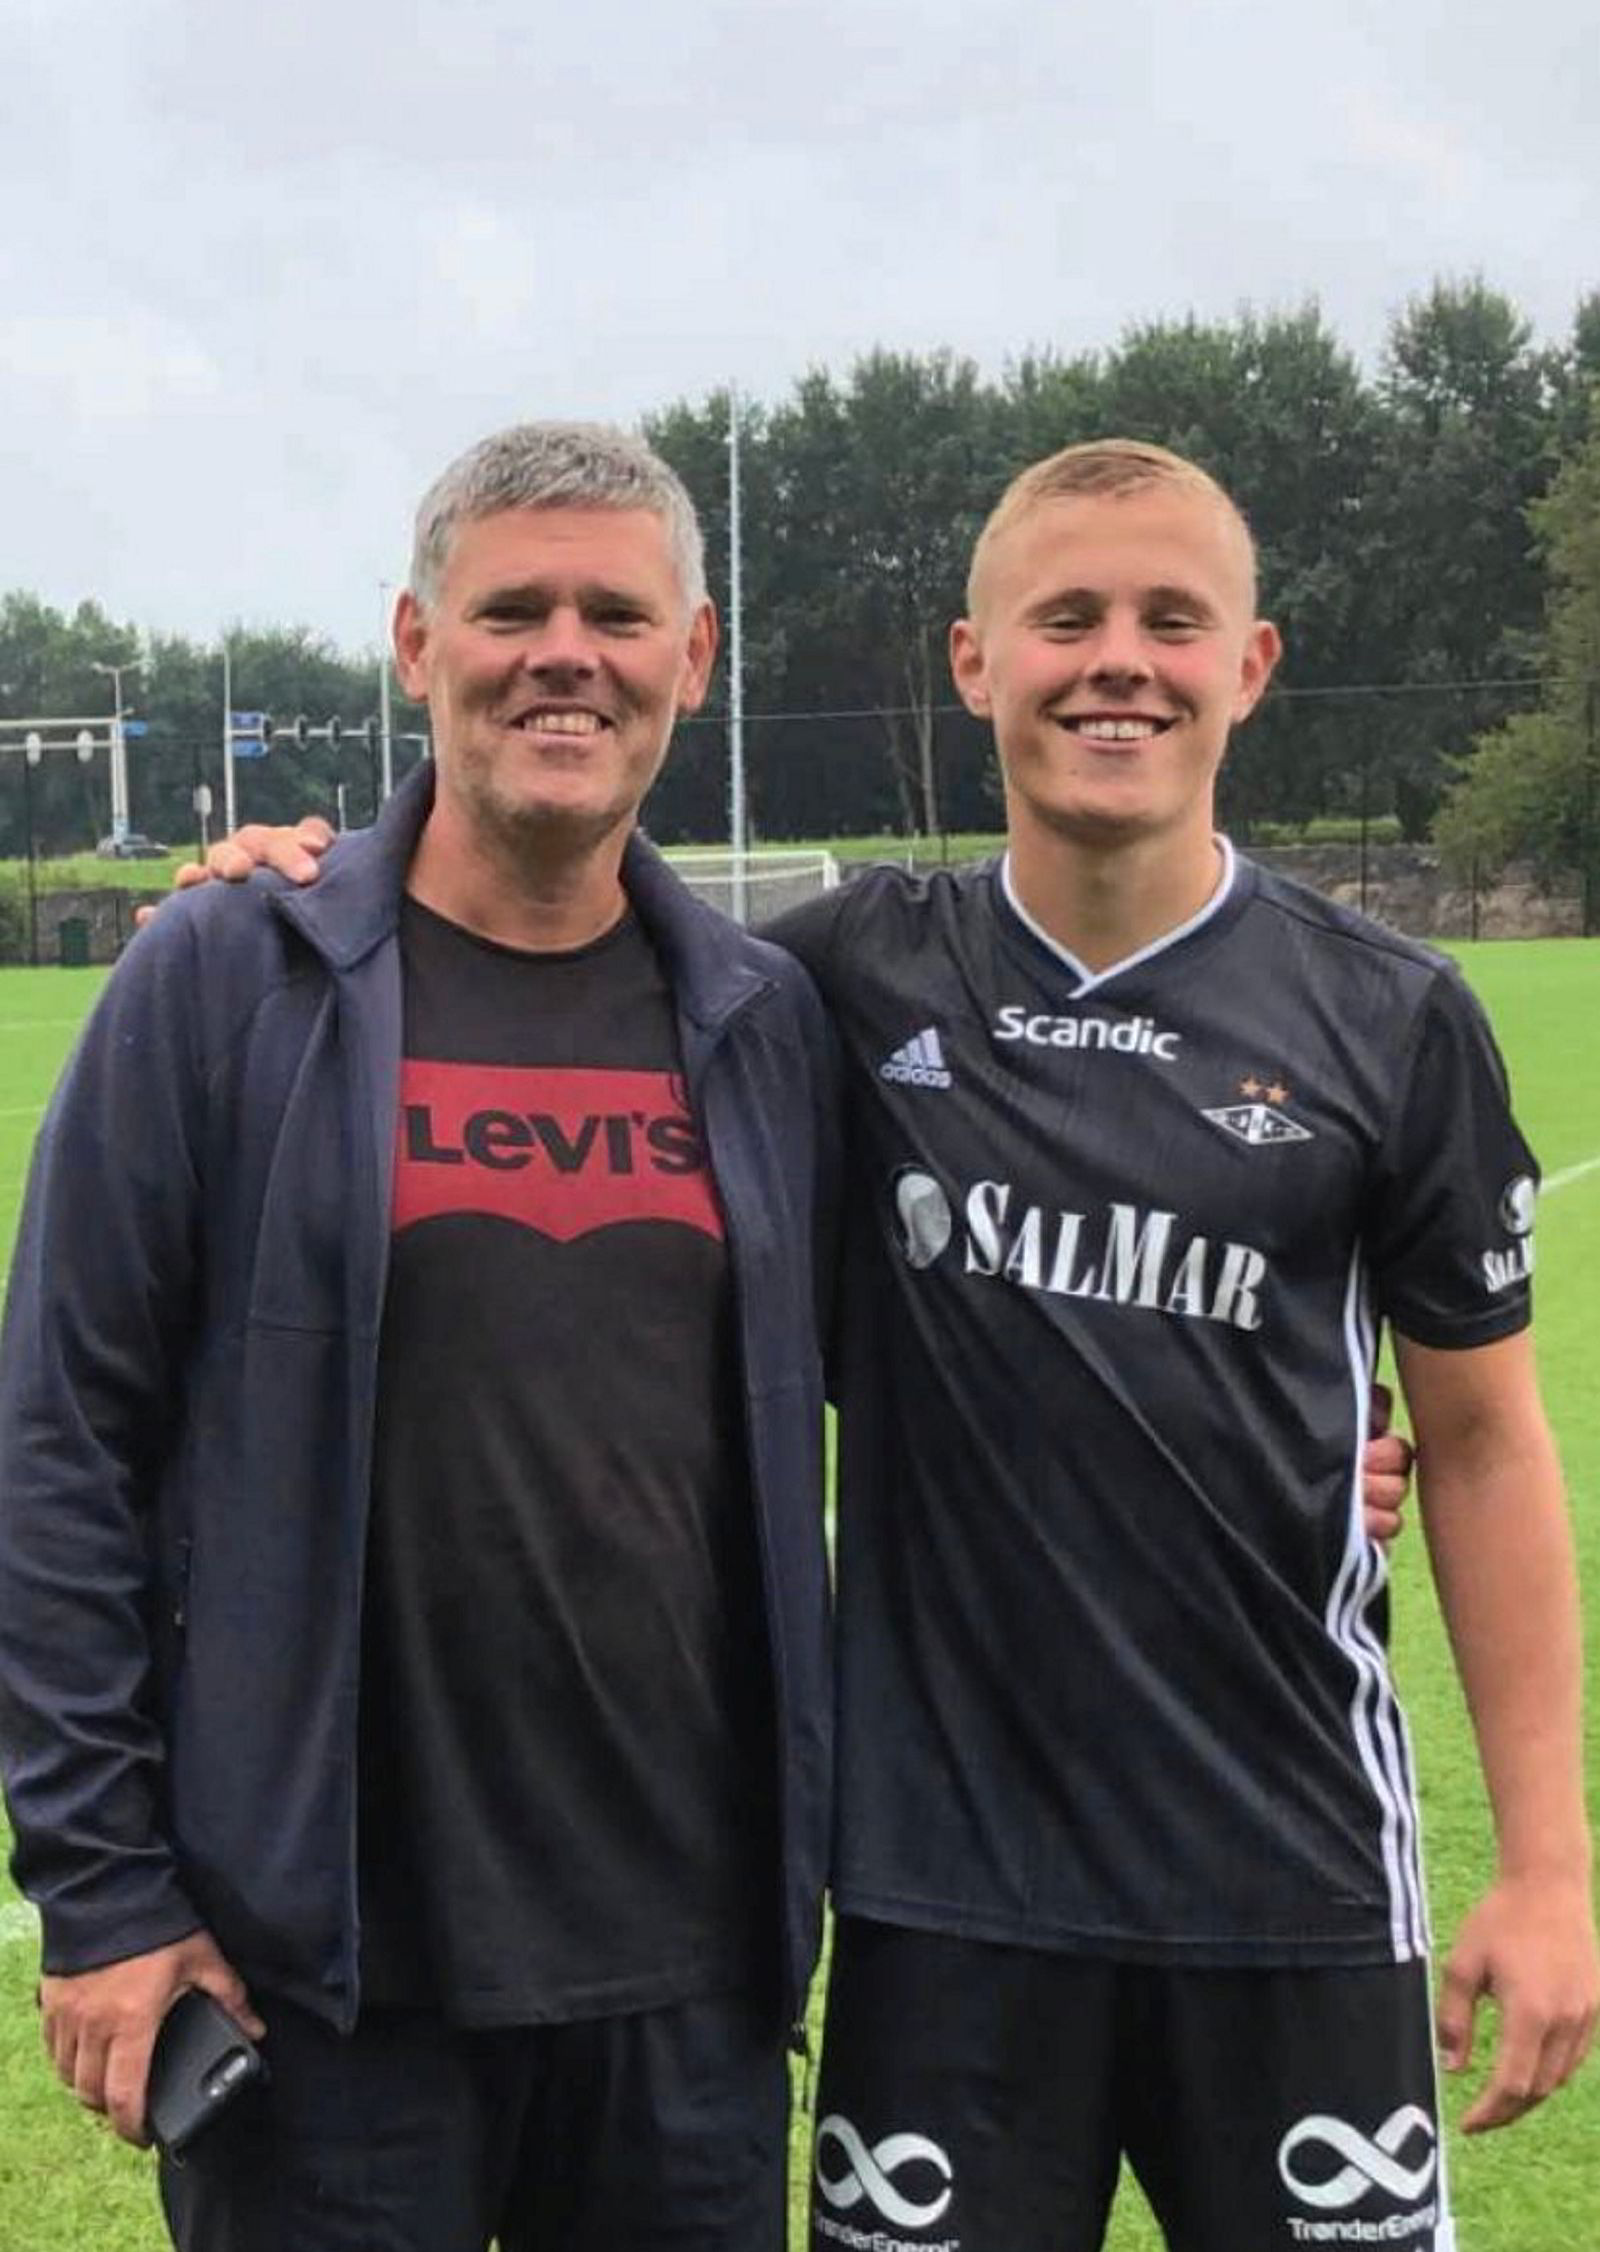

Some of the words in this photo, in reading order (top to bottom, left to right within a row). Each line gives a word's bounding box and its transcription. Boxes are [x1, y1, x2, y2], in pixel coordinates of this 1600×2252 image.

[994, 1006, 1181, 1061] Scandic
[881, 1063, 952, 1089] adidas
[964, 1179, 1266, 1332] SALMAR
